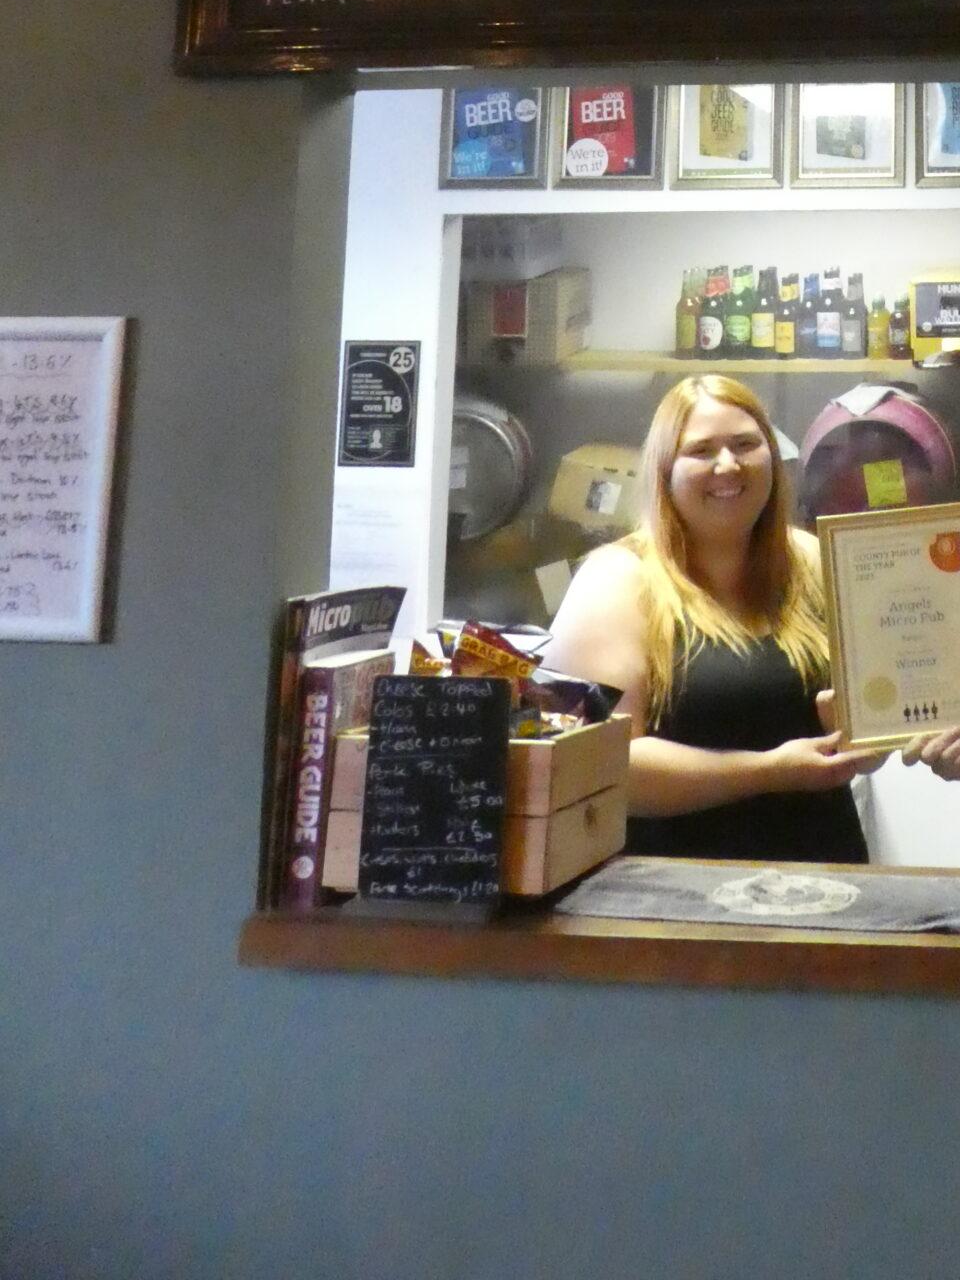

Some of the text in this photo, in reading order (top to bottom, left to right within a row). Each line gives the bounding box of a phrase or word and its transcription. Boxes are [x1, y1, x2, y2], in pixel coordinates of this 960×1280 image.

[465, 99, 513, 128] BEER
[580, 99, 627, 124] BEER
[392, 351, 413, 369] 25
[383, 396, 403, 414] 18
[888, 597, 933, 614] Angels
[879, 609, 946, 630] Micro Pub
[294, 693, 329, 845] BEER GUIDE
